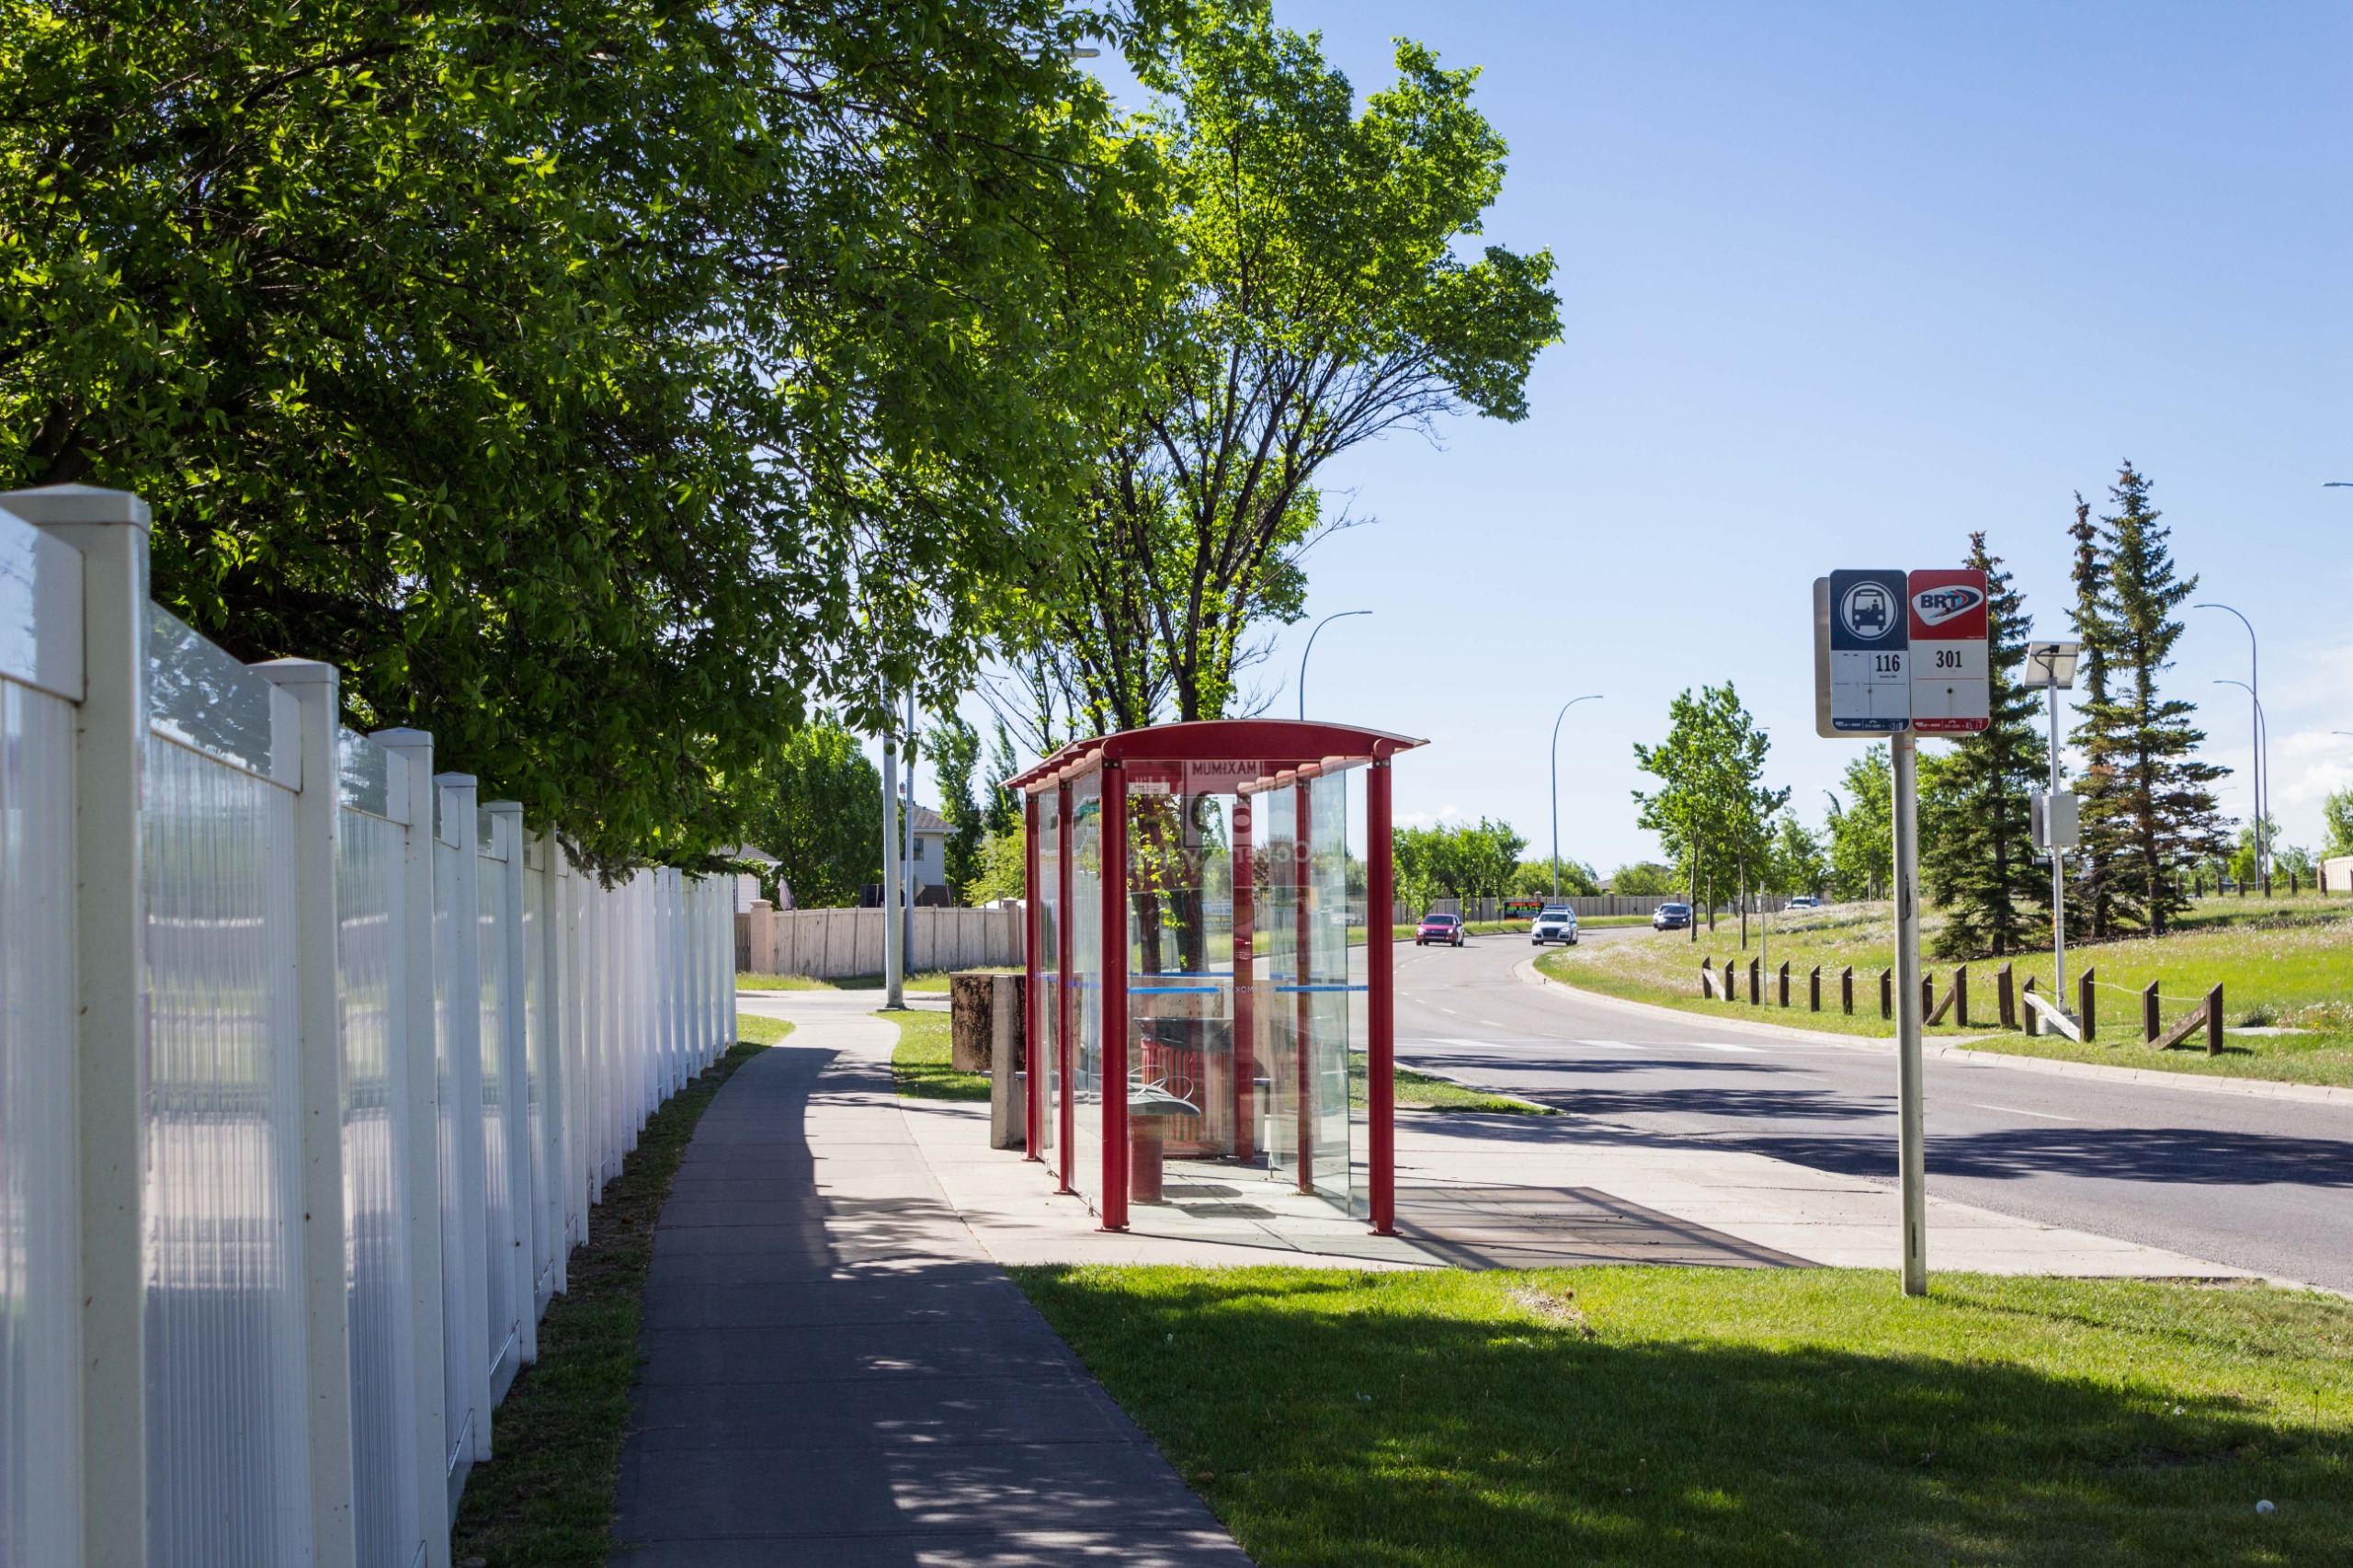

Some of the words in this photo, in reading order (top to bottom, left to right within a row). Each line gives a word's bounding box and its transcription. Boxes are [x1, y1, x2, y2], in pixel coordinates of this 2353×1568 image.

[1920, 594, 1961, 608] BRT
[1875, 653, 1901, 672] 116
[1936, 650, 1962, 668] 301
